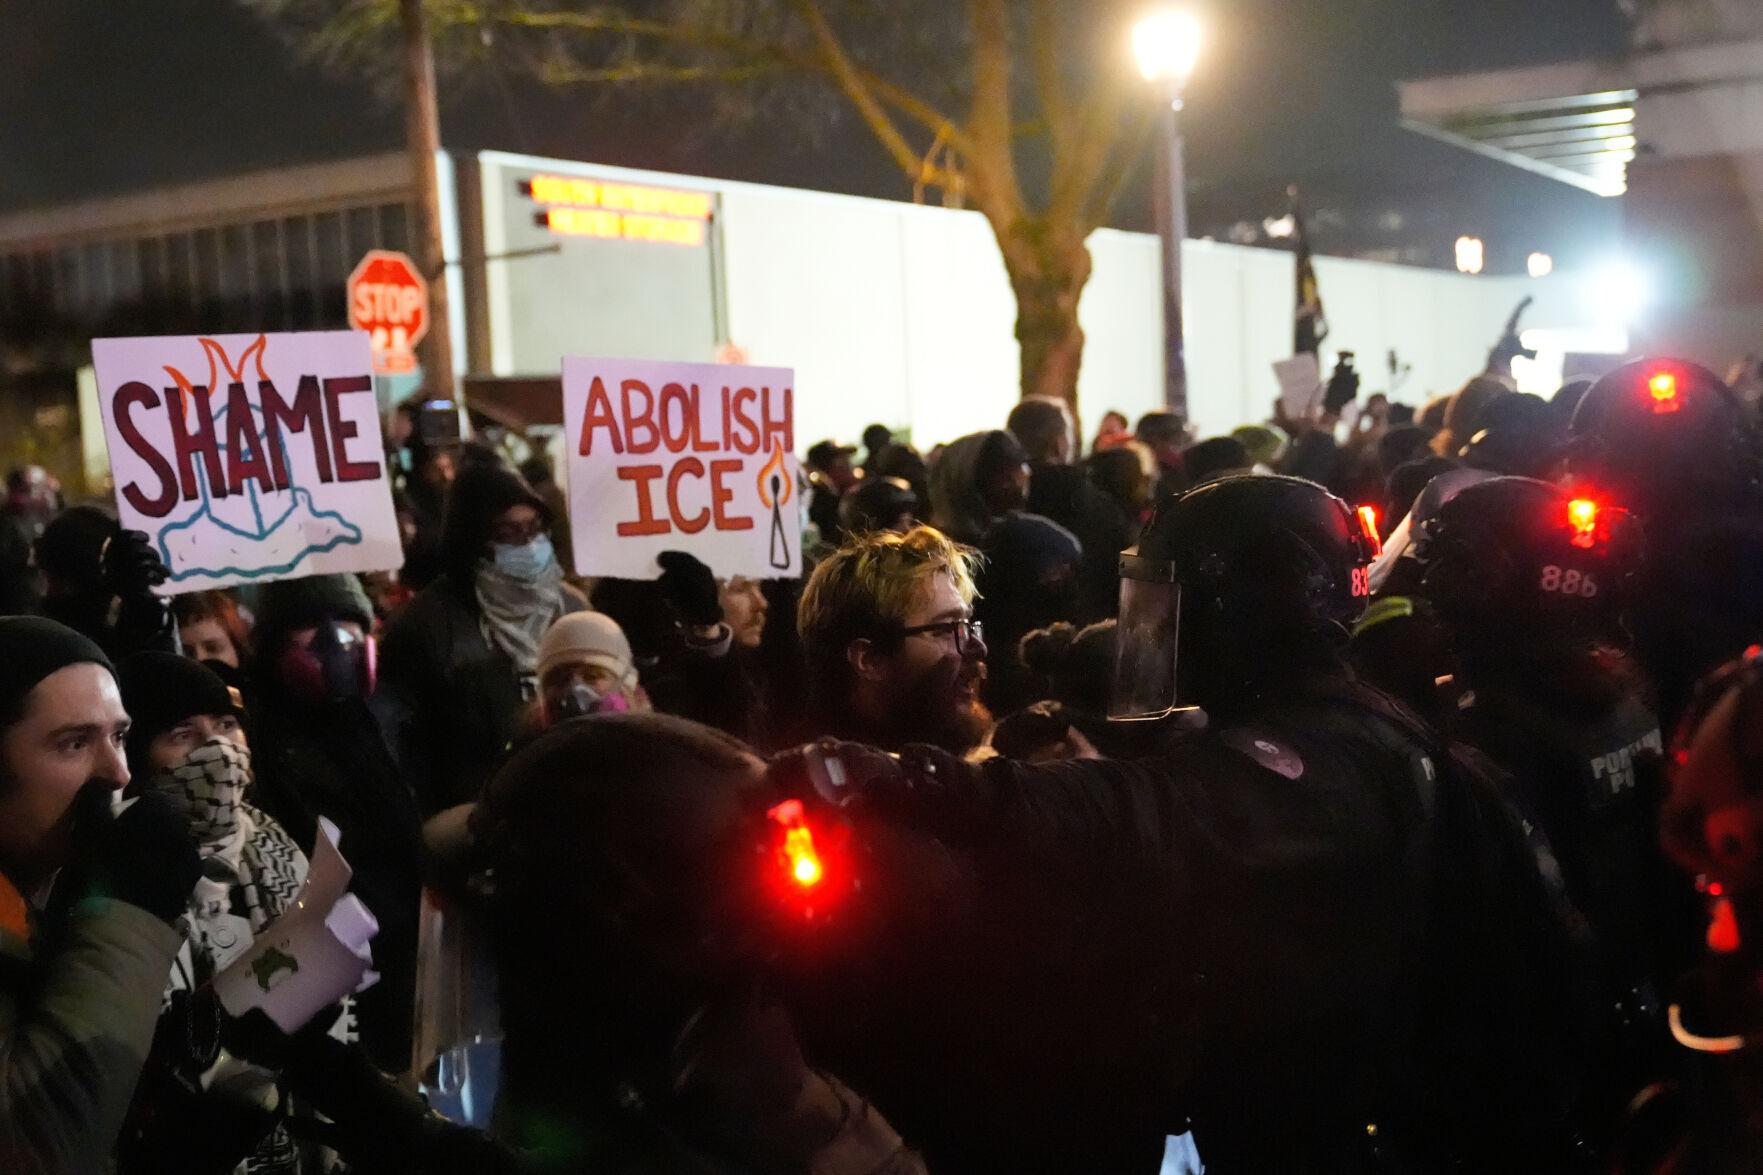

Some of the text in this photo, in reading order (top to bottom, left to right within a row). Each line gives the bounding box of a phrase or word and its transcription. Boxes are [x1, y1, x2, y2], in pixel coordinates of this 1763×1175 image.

[355, 282, 420, 324] STOP
[112, 375, 381, 518] SHAME
[579, 376, 794, 456] ABOLISH
[616, 456, 754, 537] ICE
